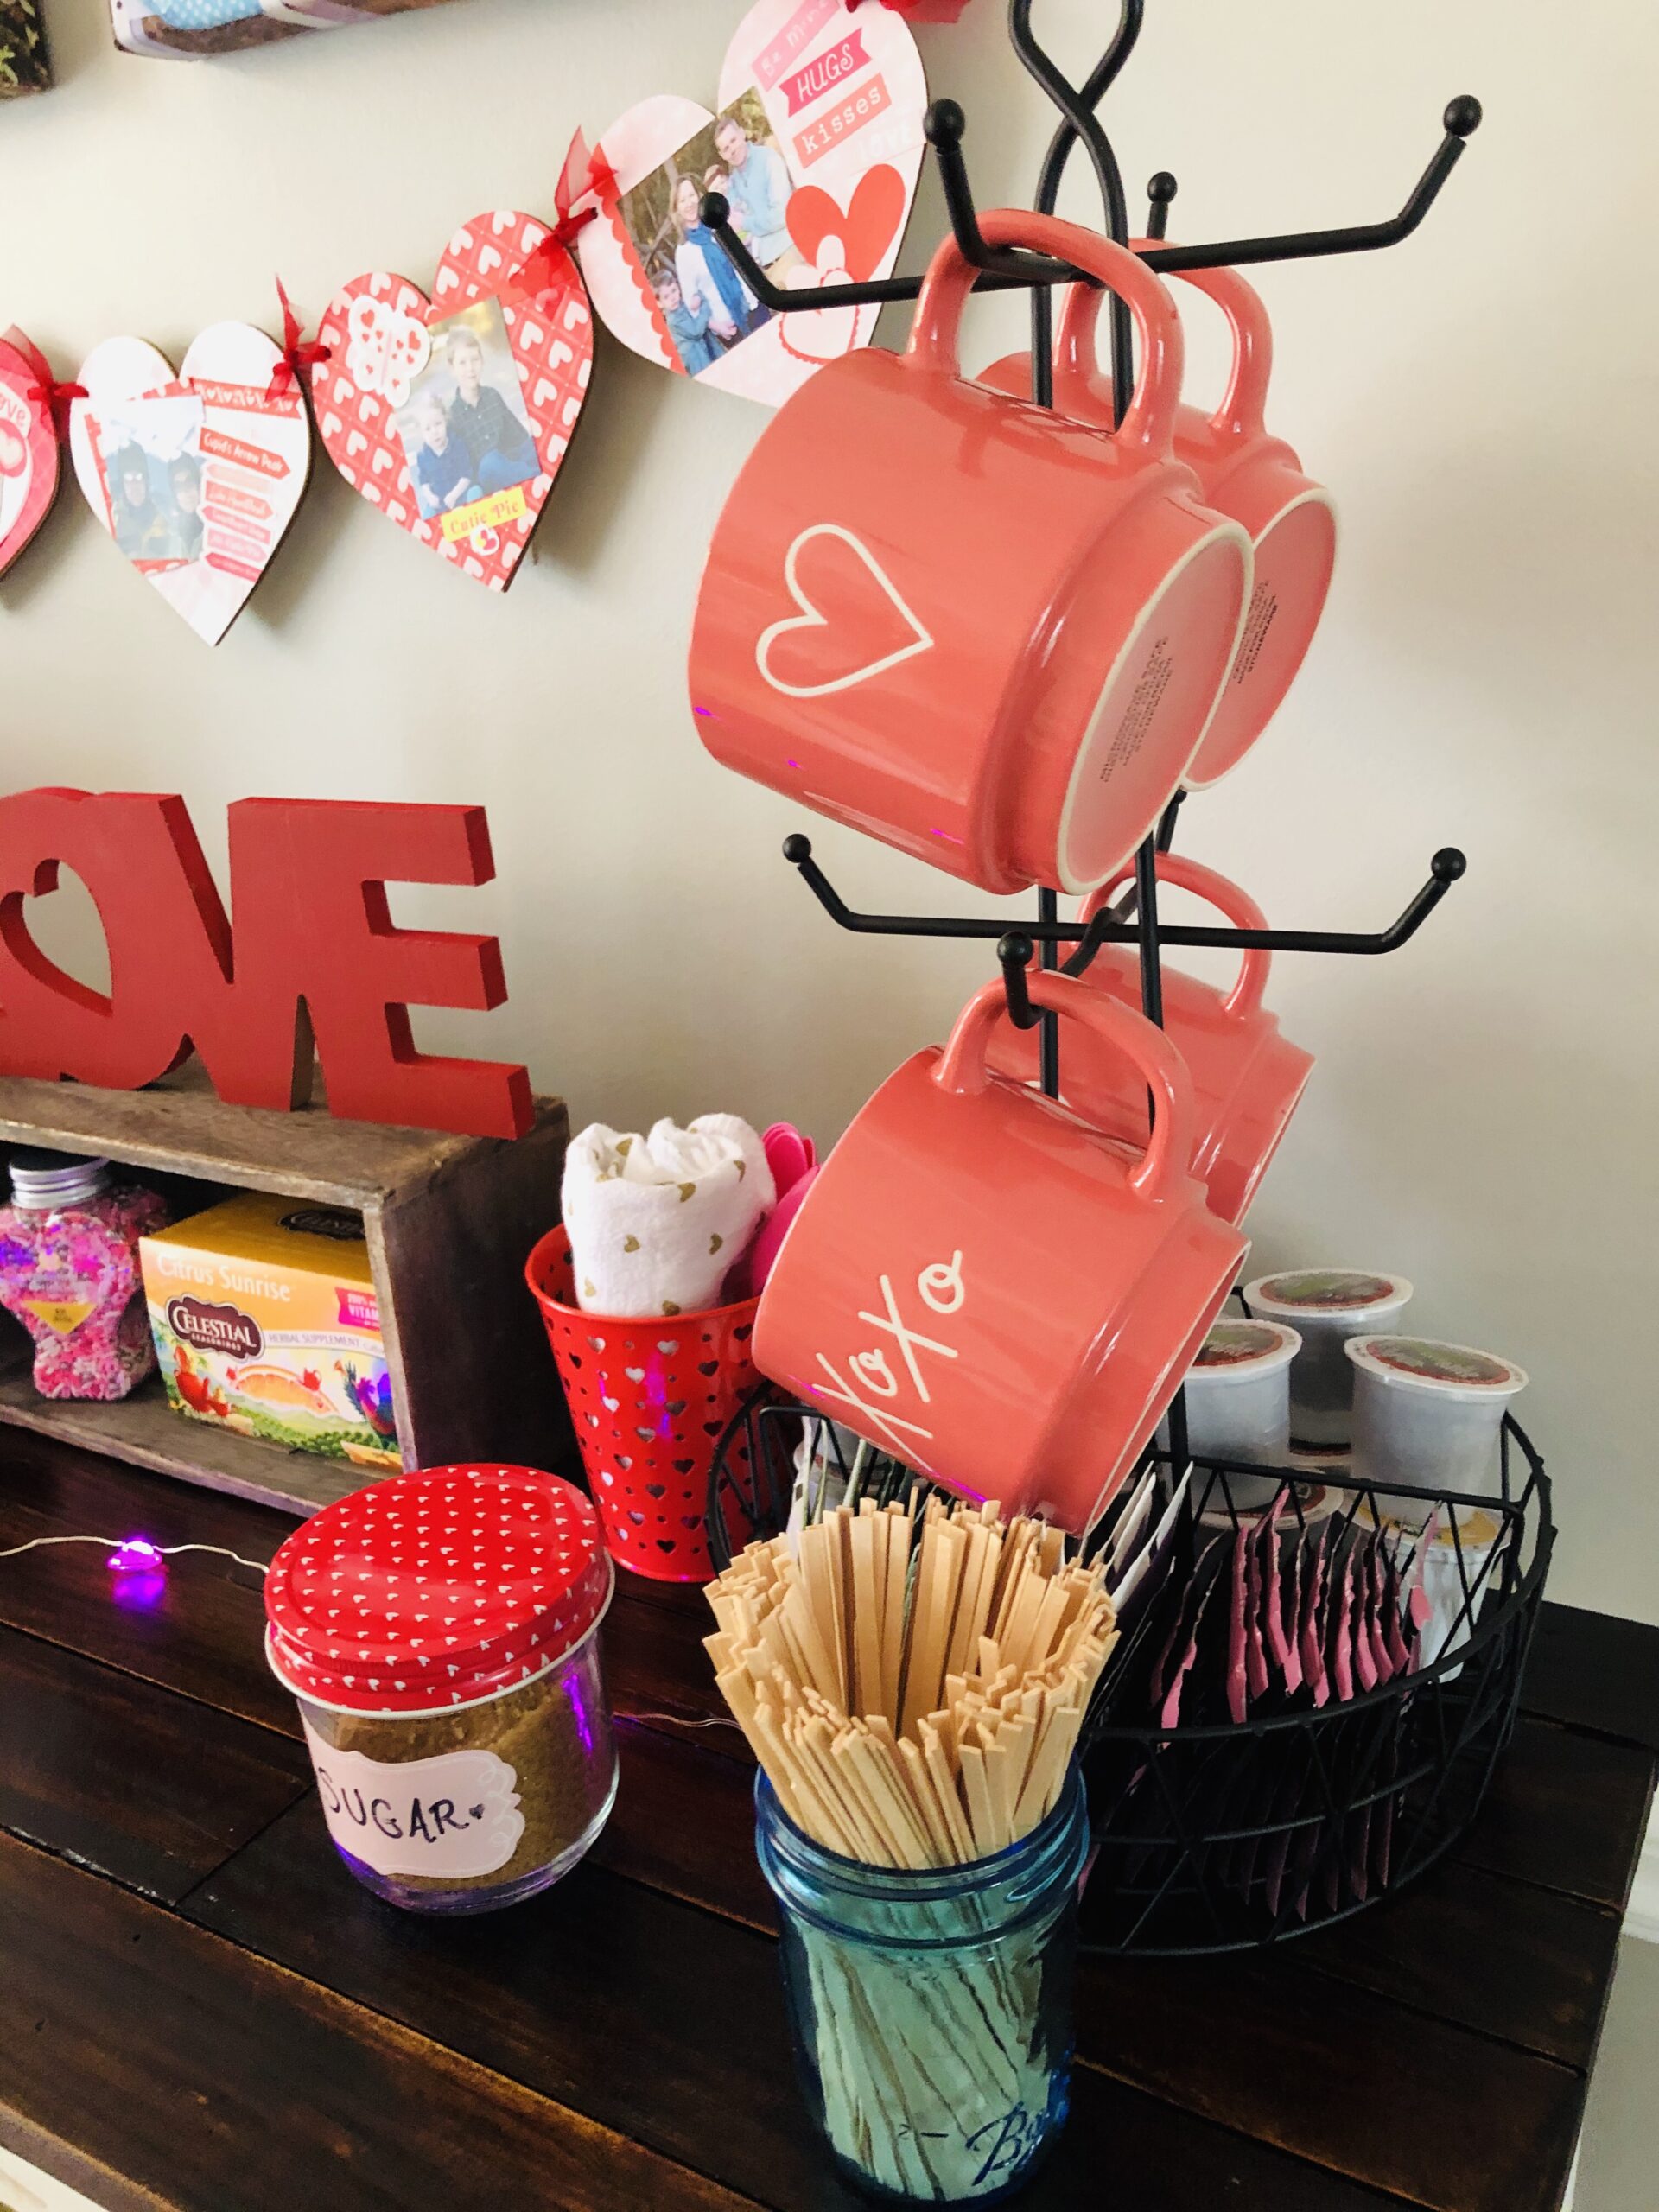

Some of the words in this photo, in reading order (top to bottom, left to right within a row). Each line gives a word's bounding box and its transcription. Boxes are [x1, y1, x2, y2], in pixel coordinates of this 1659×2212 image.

[796, 43, 855, 103] HUGS
[801, 86, 882, 156] kisses
[156, 1253, 215, 1287] Citrus
[219, 1265, 291, 1302] Sunrise
[173, 1306, 257, 1348] CELESTIAL
[269, 1333, 300, 1344] HERBAL
[302, 1333, 360, 1348] SUPPLEMENT
[318, 1766, 471, 1843] SUGAR
